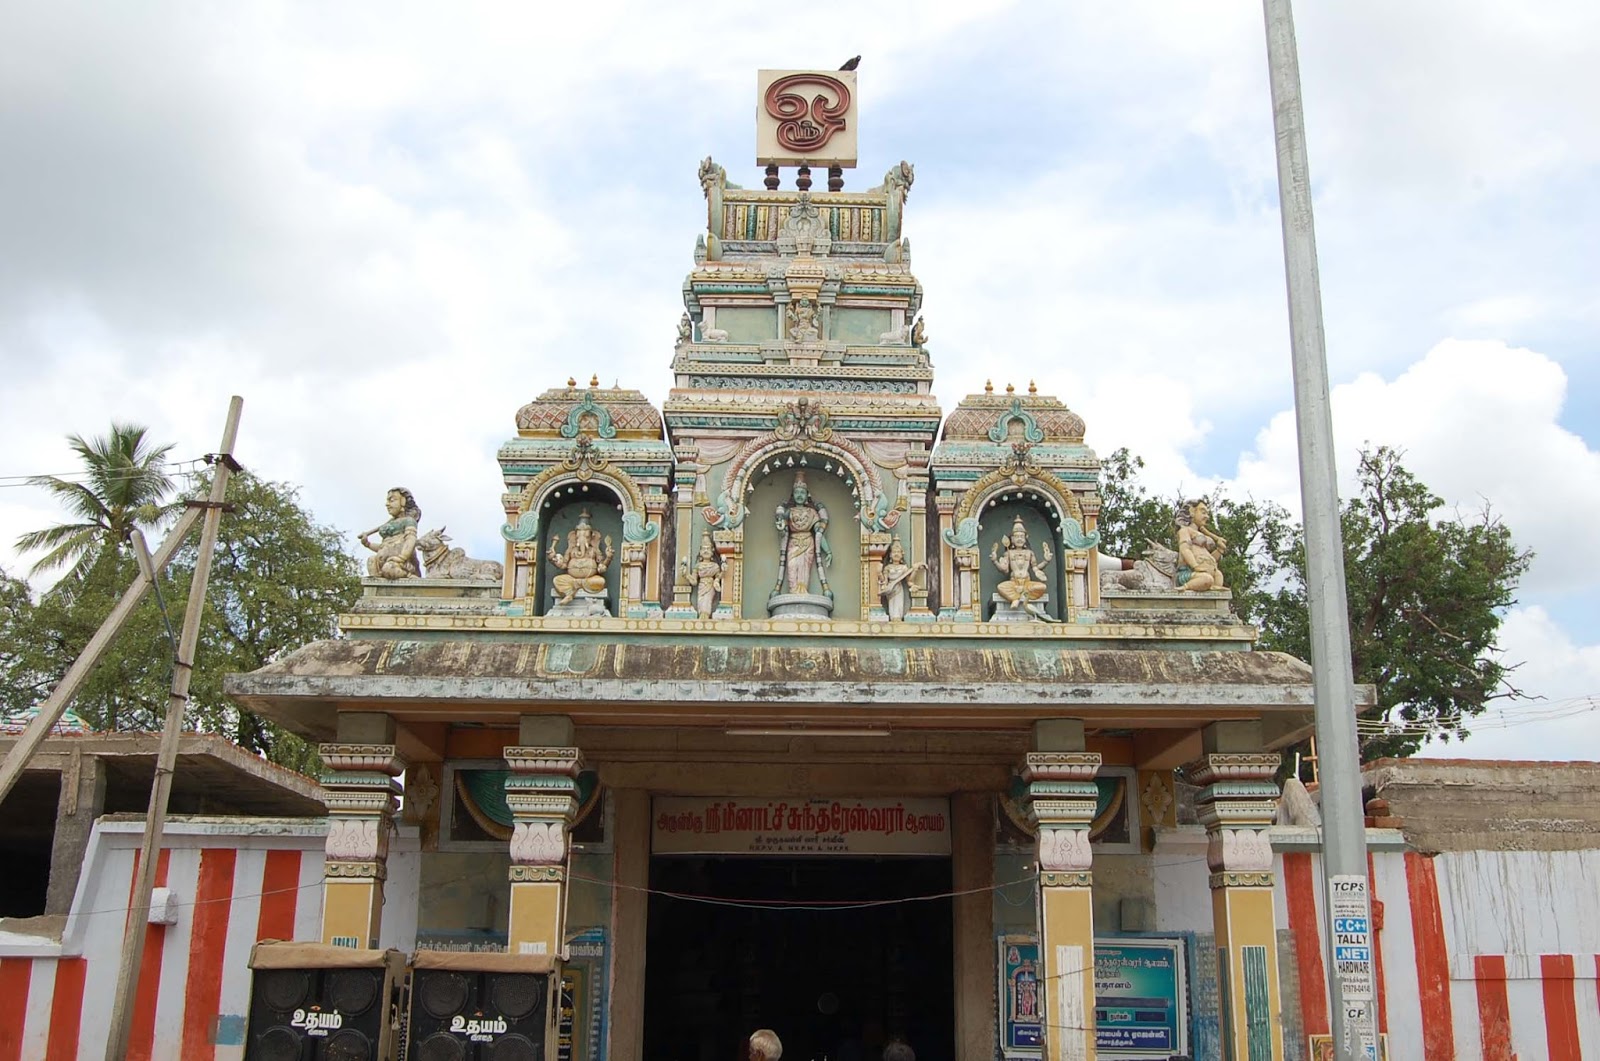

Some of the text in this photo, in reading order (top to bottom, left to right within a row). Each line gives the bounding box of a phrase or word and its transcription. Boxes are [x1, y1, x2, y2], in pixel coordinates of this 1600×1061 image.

[657, 812, 703, 833] அருள்மிகு
[723, 802, 787, 831] மீனாட்சி
[787, 802, 904, 836] சுந்தரேஸ்வரர்
[905, 812, 945, 834] ஆலயம்
[1333, 882, 1365, 892] TCPS
[1337, 934, 1367, 945] TALLY
[1338, 948, 1369, 960] .NET
[1338, 961, 1369, 974] HARDWARE
[291, 1008, 343, 1030] உதயம்
[450, 1015, 508, 1036] உதயம்
